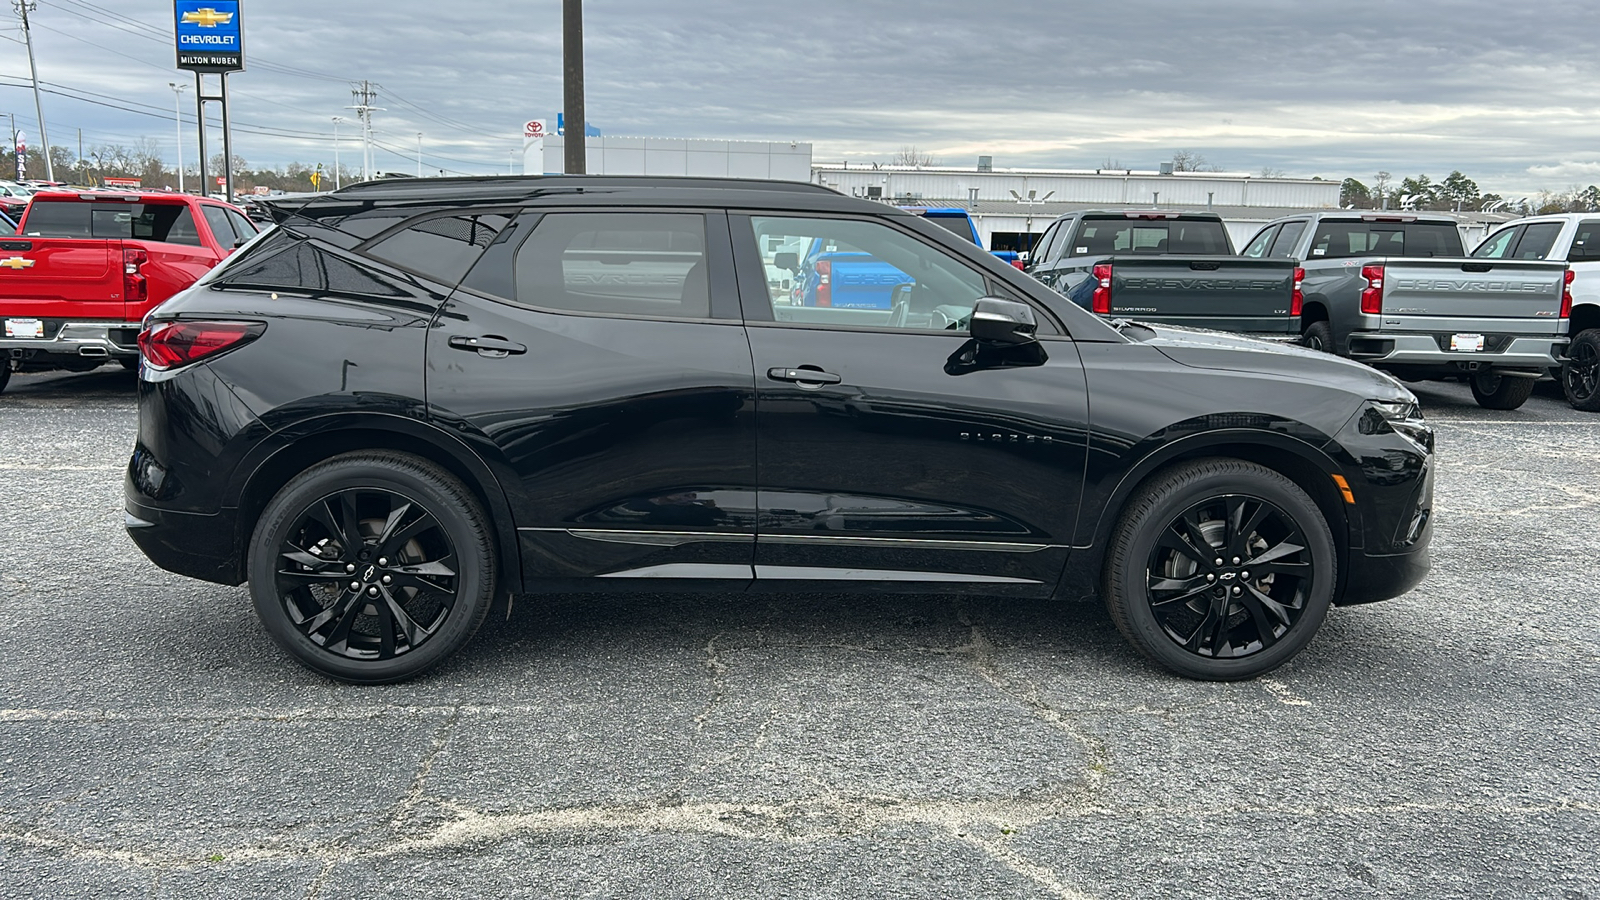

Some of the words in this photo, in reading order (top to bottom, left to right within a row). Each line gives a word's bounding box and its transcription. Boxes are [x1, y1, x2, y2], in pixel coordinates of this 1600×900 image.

[180, 34, 235, 45] CHEVROLET
[180, 56, 208, 65] MILTON
[211, 56, 237, 65] RUBEN
[562, 273, 687, 285] EVROLE
[1125, 278, 1286, 291] CHEVROLET
[1397, 279, 1553, 293] CHEVROLET
[960, 432, 1053, 444] BLAZER
